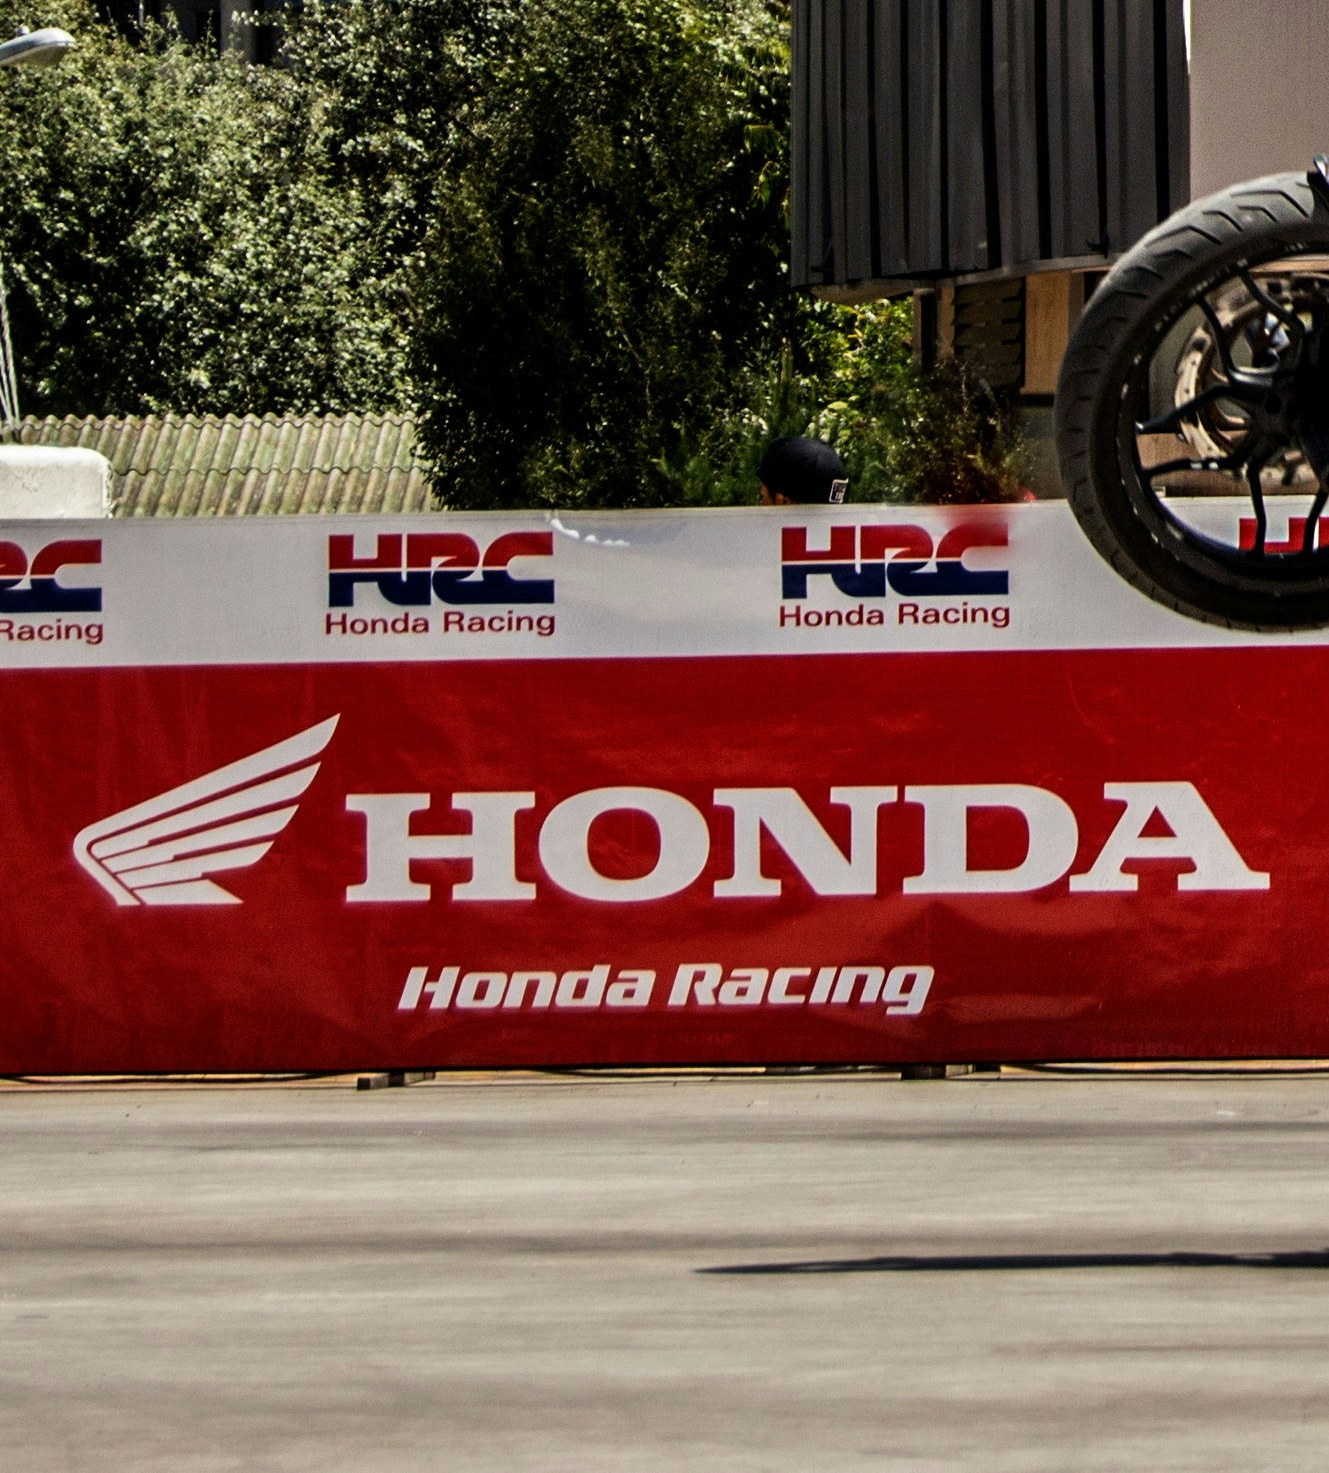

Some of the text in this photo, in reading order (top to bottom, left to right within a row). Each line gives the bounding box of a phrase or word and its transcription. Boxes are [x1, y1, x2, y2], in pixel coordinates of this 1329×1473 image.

[328, 531, 555, 608] HRC
[781, 524, 1009, 600] HRC
[325, 610, 556, 636] Honda Racing
[779, 602, 1010, 629] Honda Racing
[345, 781, 1271, 904] HONDA
[398, 963, 935, 1016] Honda Racing
